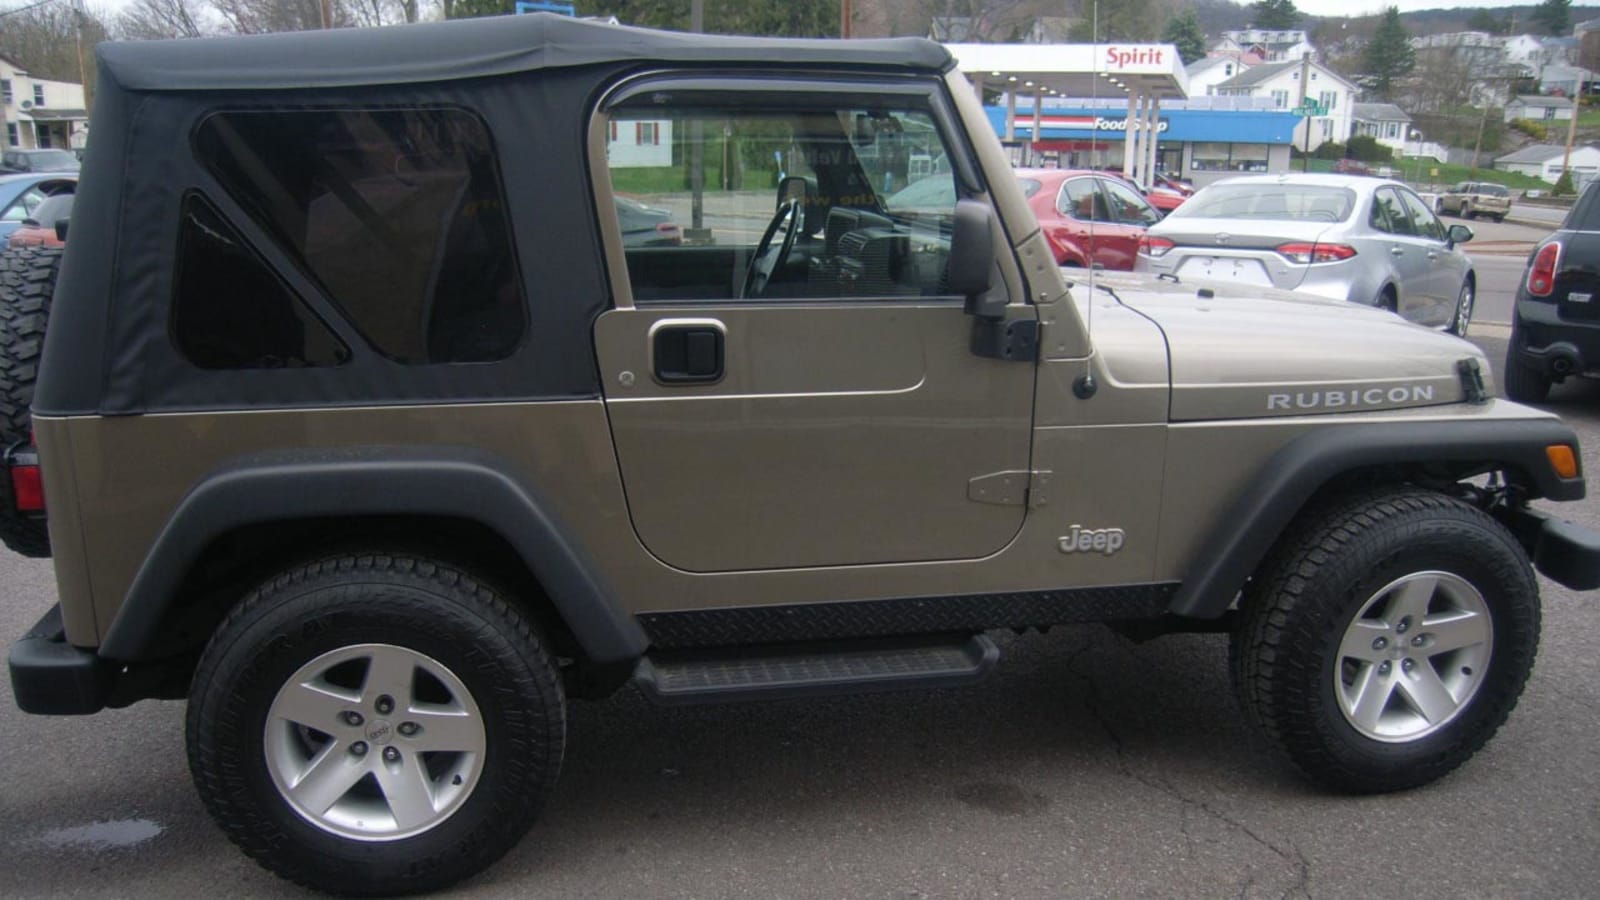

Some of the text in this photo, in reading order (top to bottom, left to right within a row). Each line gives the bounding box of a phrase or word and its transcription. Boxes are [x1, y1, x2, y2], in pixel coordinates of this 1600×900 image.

[1106, 47, 1163, 69] Spirit
[1094, 117, 1168, 133] Food Sp
[1267, 385, 1433, 409] RUBICON
[1058, 524, 1125, 556] Jeep
